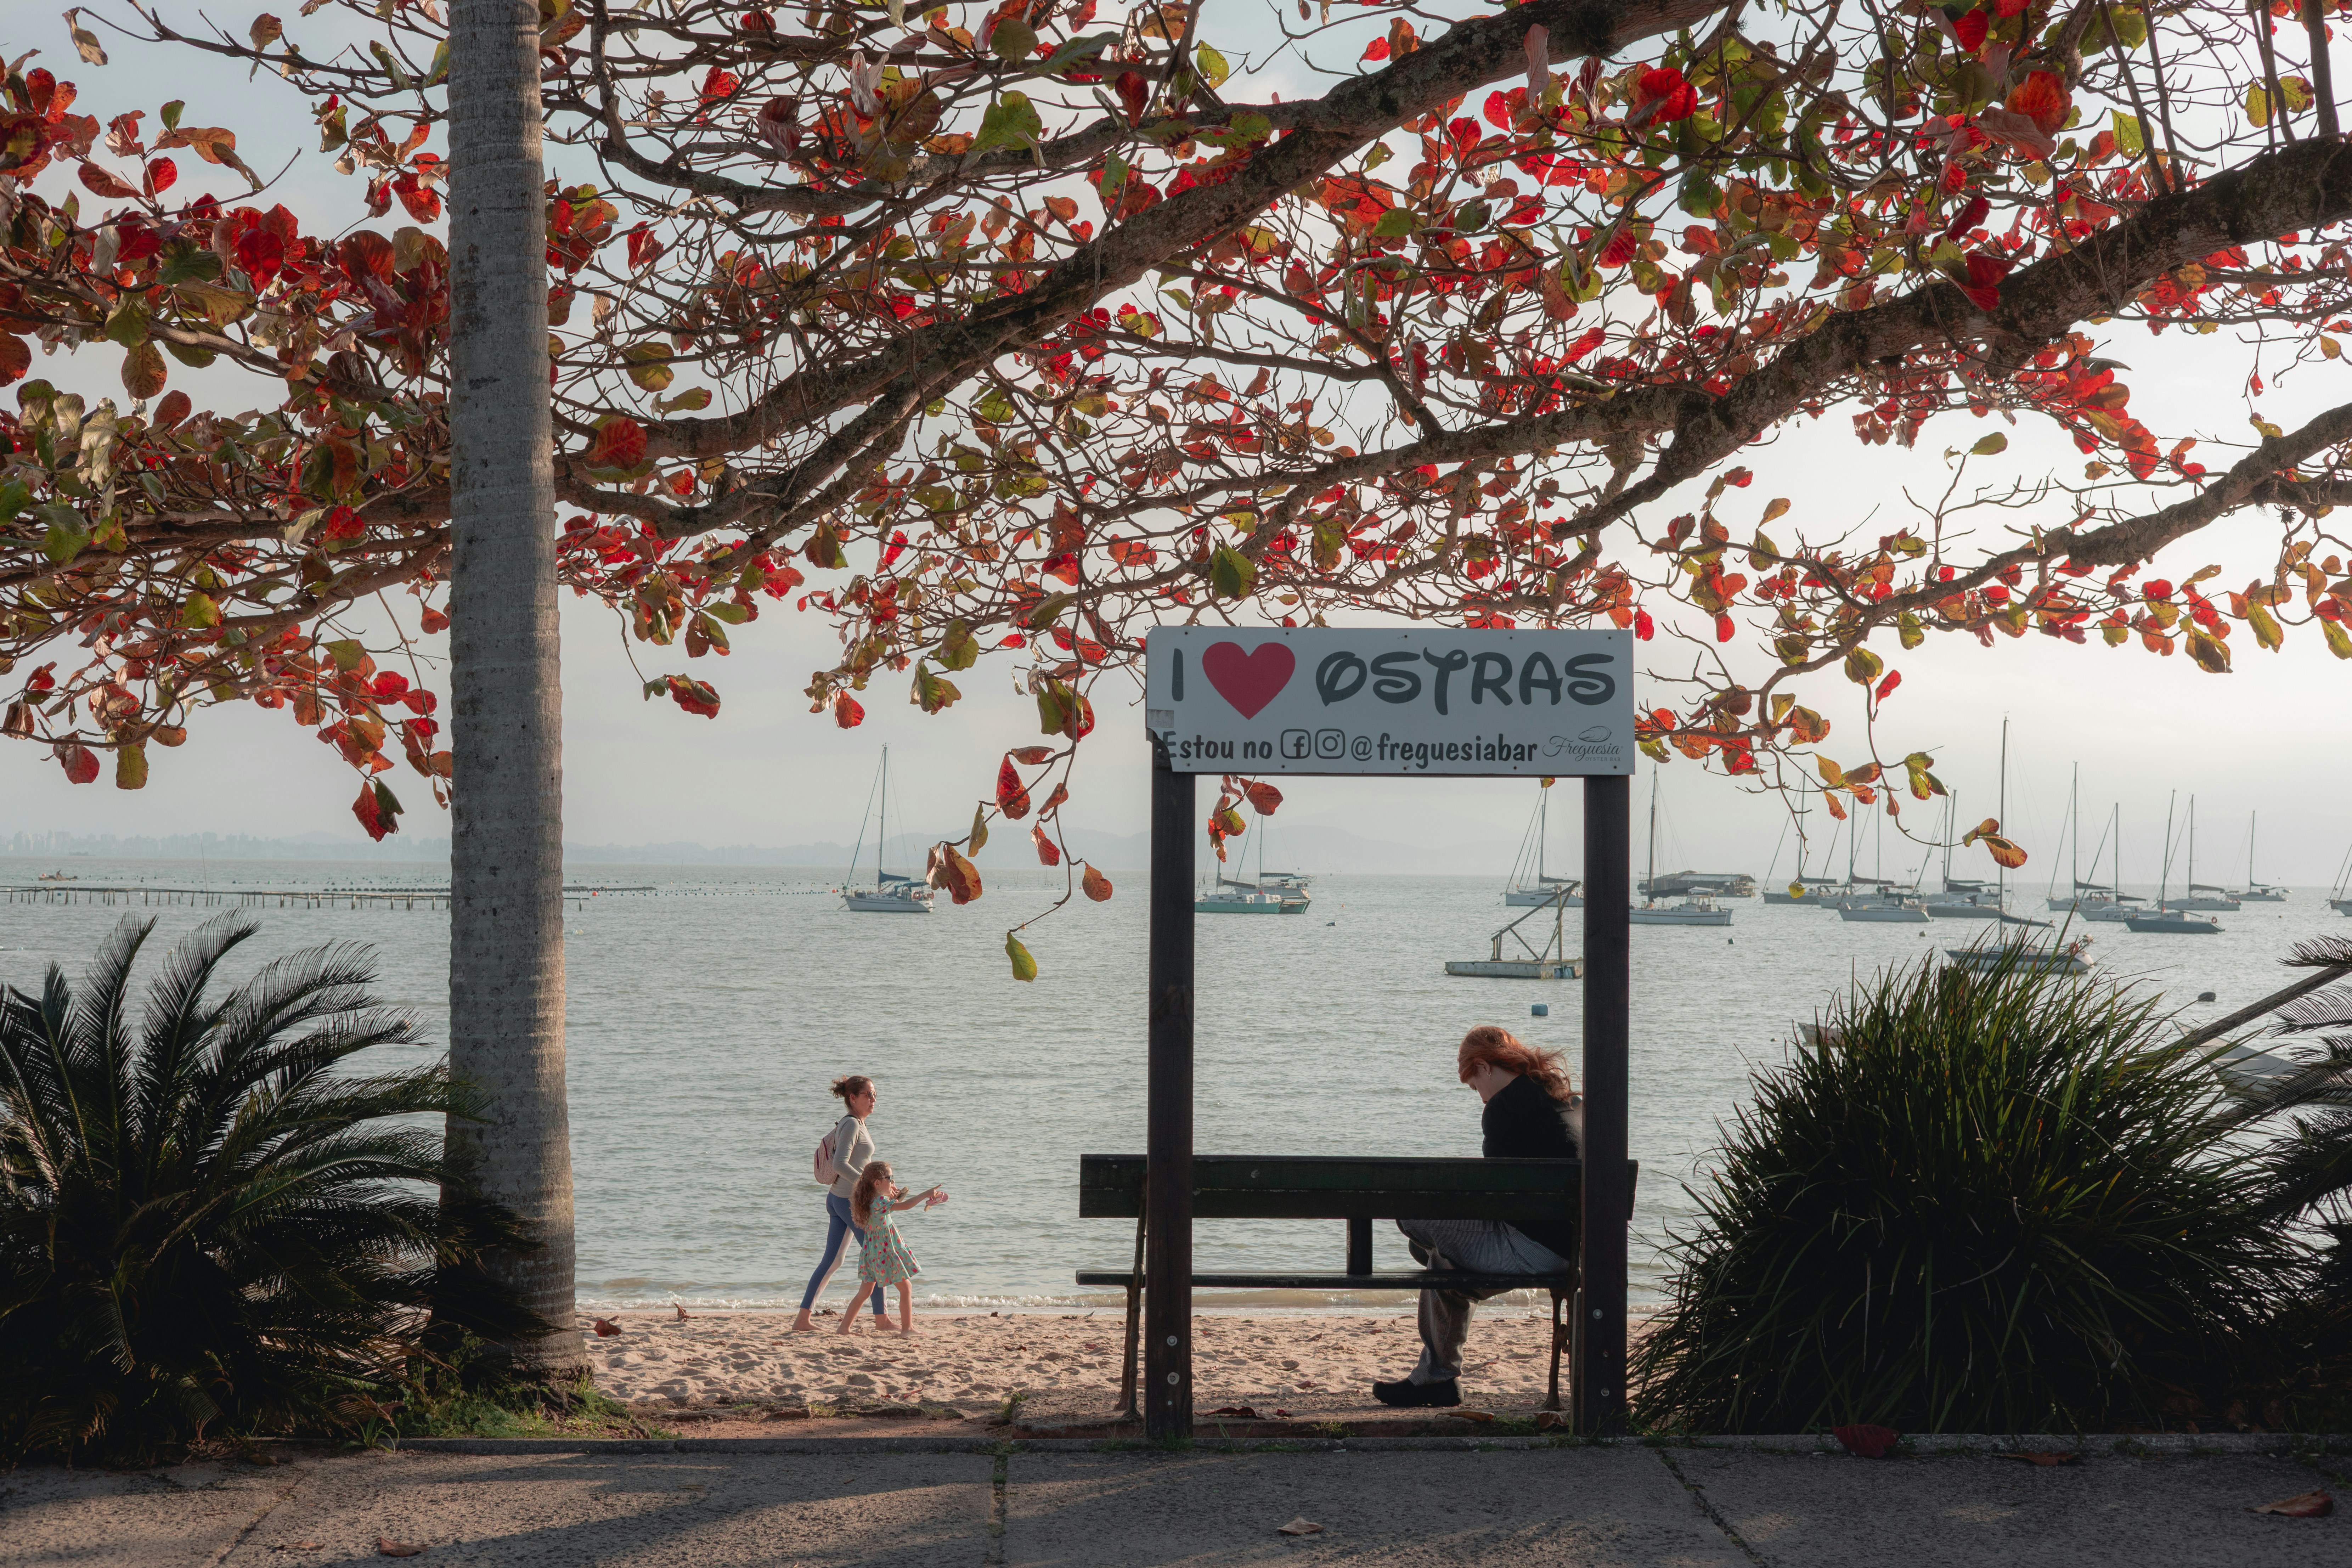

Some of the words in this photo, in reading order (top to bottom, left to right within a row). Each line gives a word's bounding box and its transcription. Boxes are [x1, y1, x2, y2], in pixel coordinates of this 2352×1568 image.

[1172, 648, 1184, 702] I
[1315, 647, 1616, 716] OSTRAS
[1162, 731, 1234, 760] Estou
[1243, 740, 1273, 760] no
[1542, 735, 1621, 762] Freguesia
